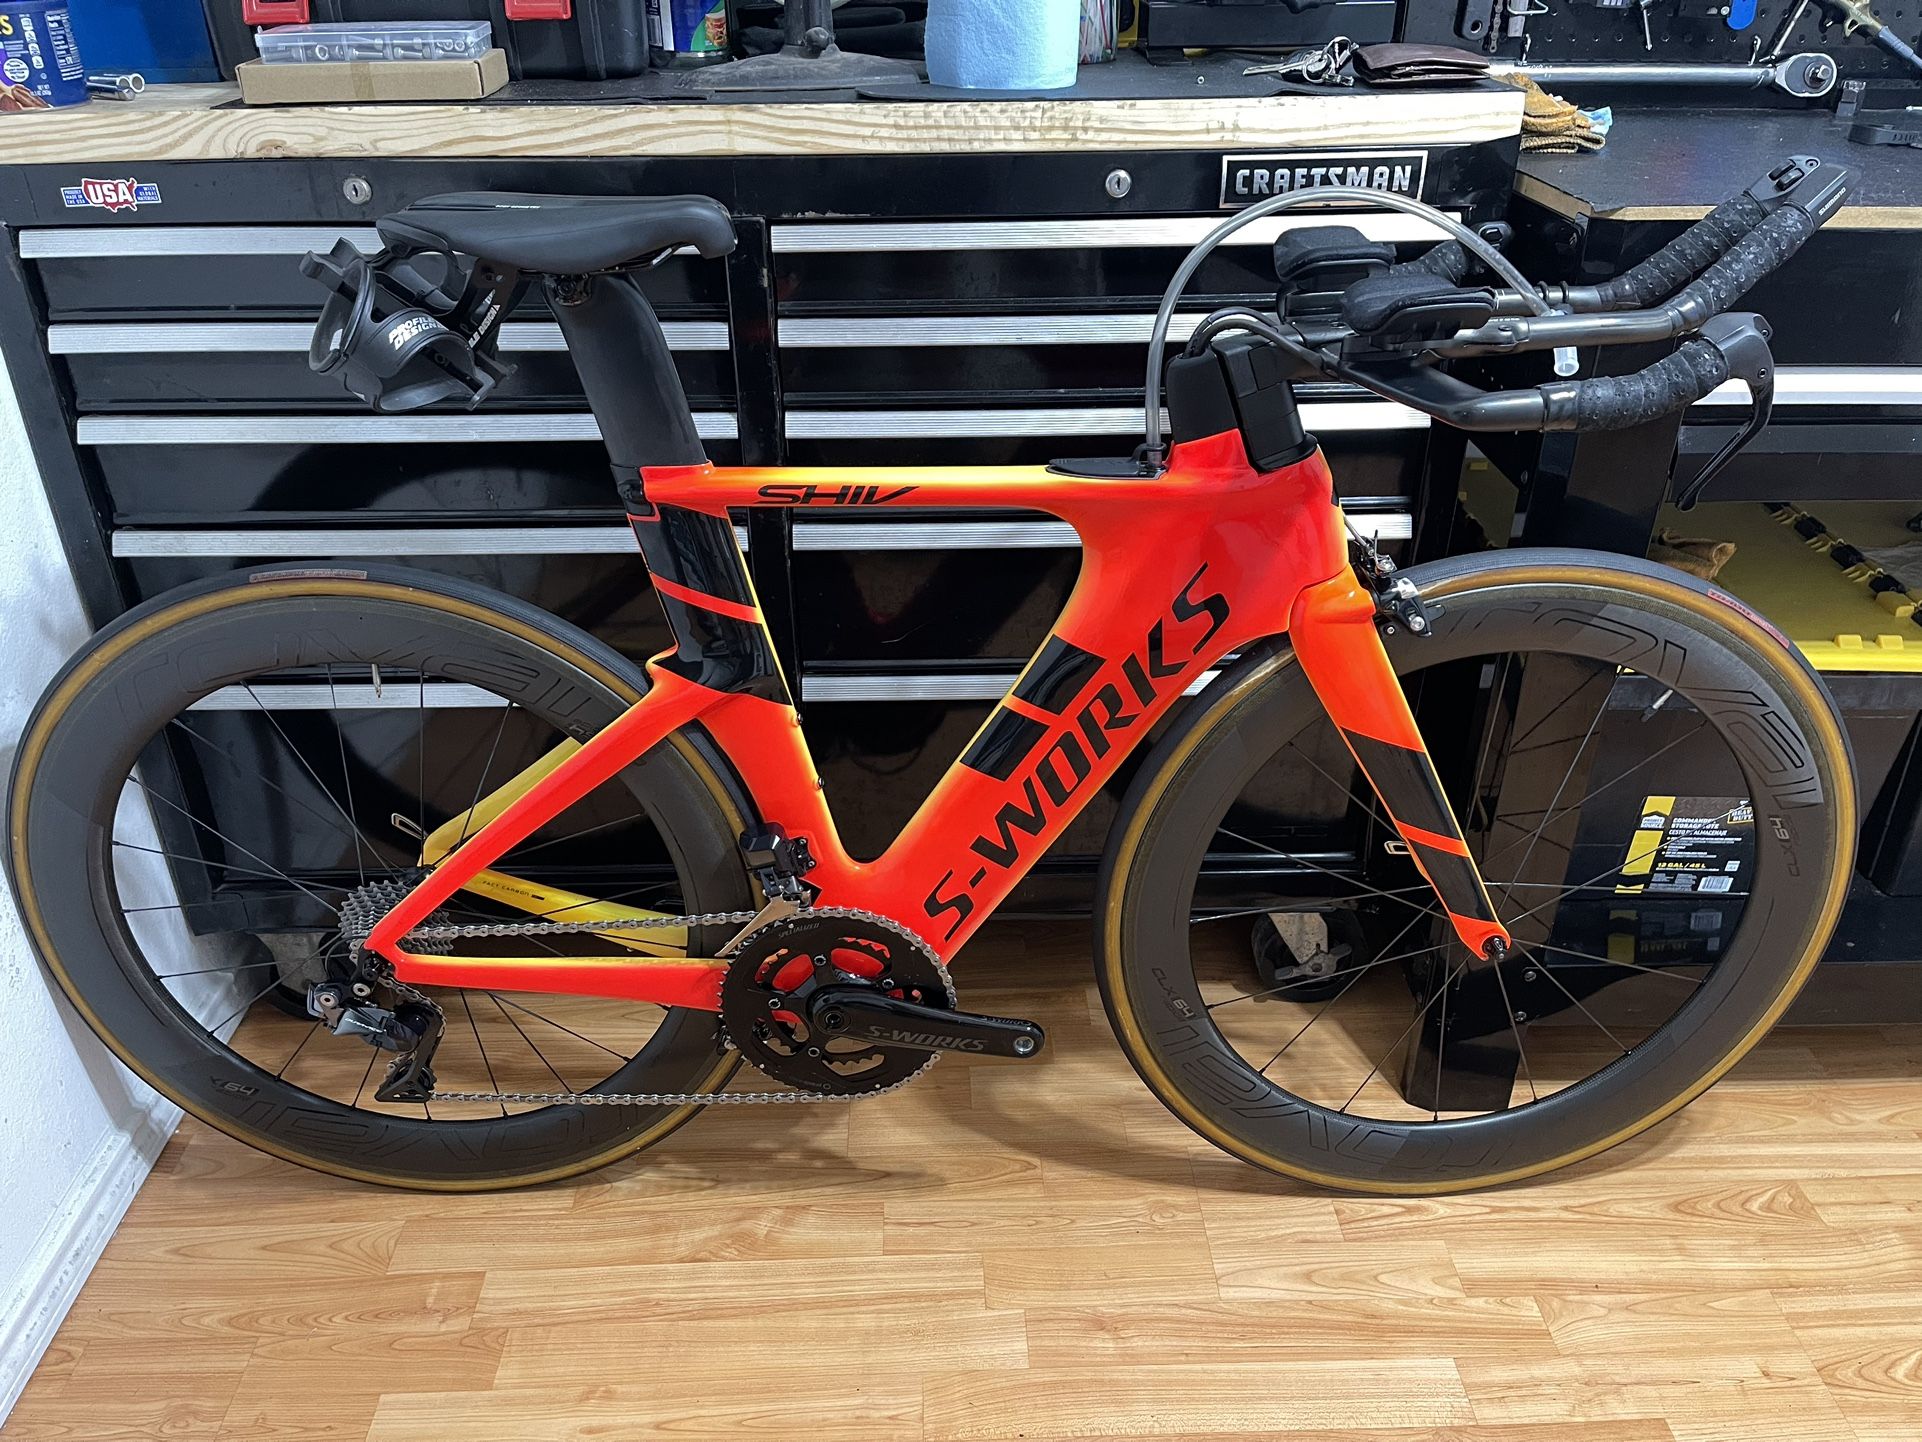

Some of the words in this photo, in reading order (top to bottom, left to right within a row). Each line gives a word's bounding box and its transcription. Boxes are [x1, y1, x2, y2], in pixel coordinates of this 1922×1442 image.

[87, 183, 134, 204] USA
[1234, 164, 1412, 196] CRAFTSMAN
[1818, 187, 1847, 216] SHIMANO
[753, 484, 921, 505] SHIV
[922, 561, 1231, 943] S-WORKS
[864, 1025, 986, 1051] S-WORKS
